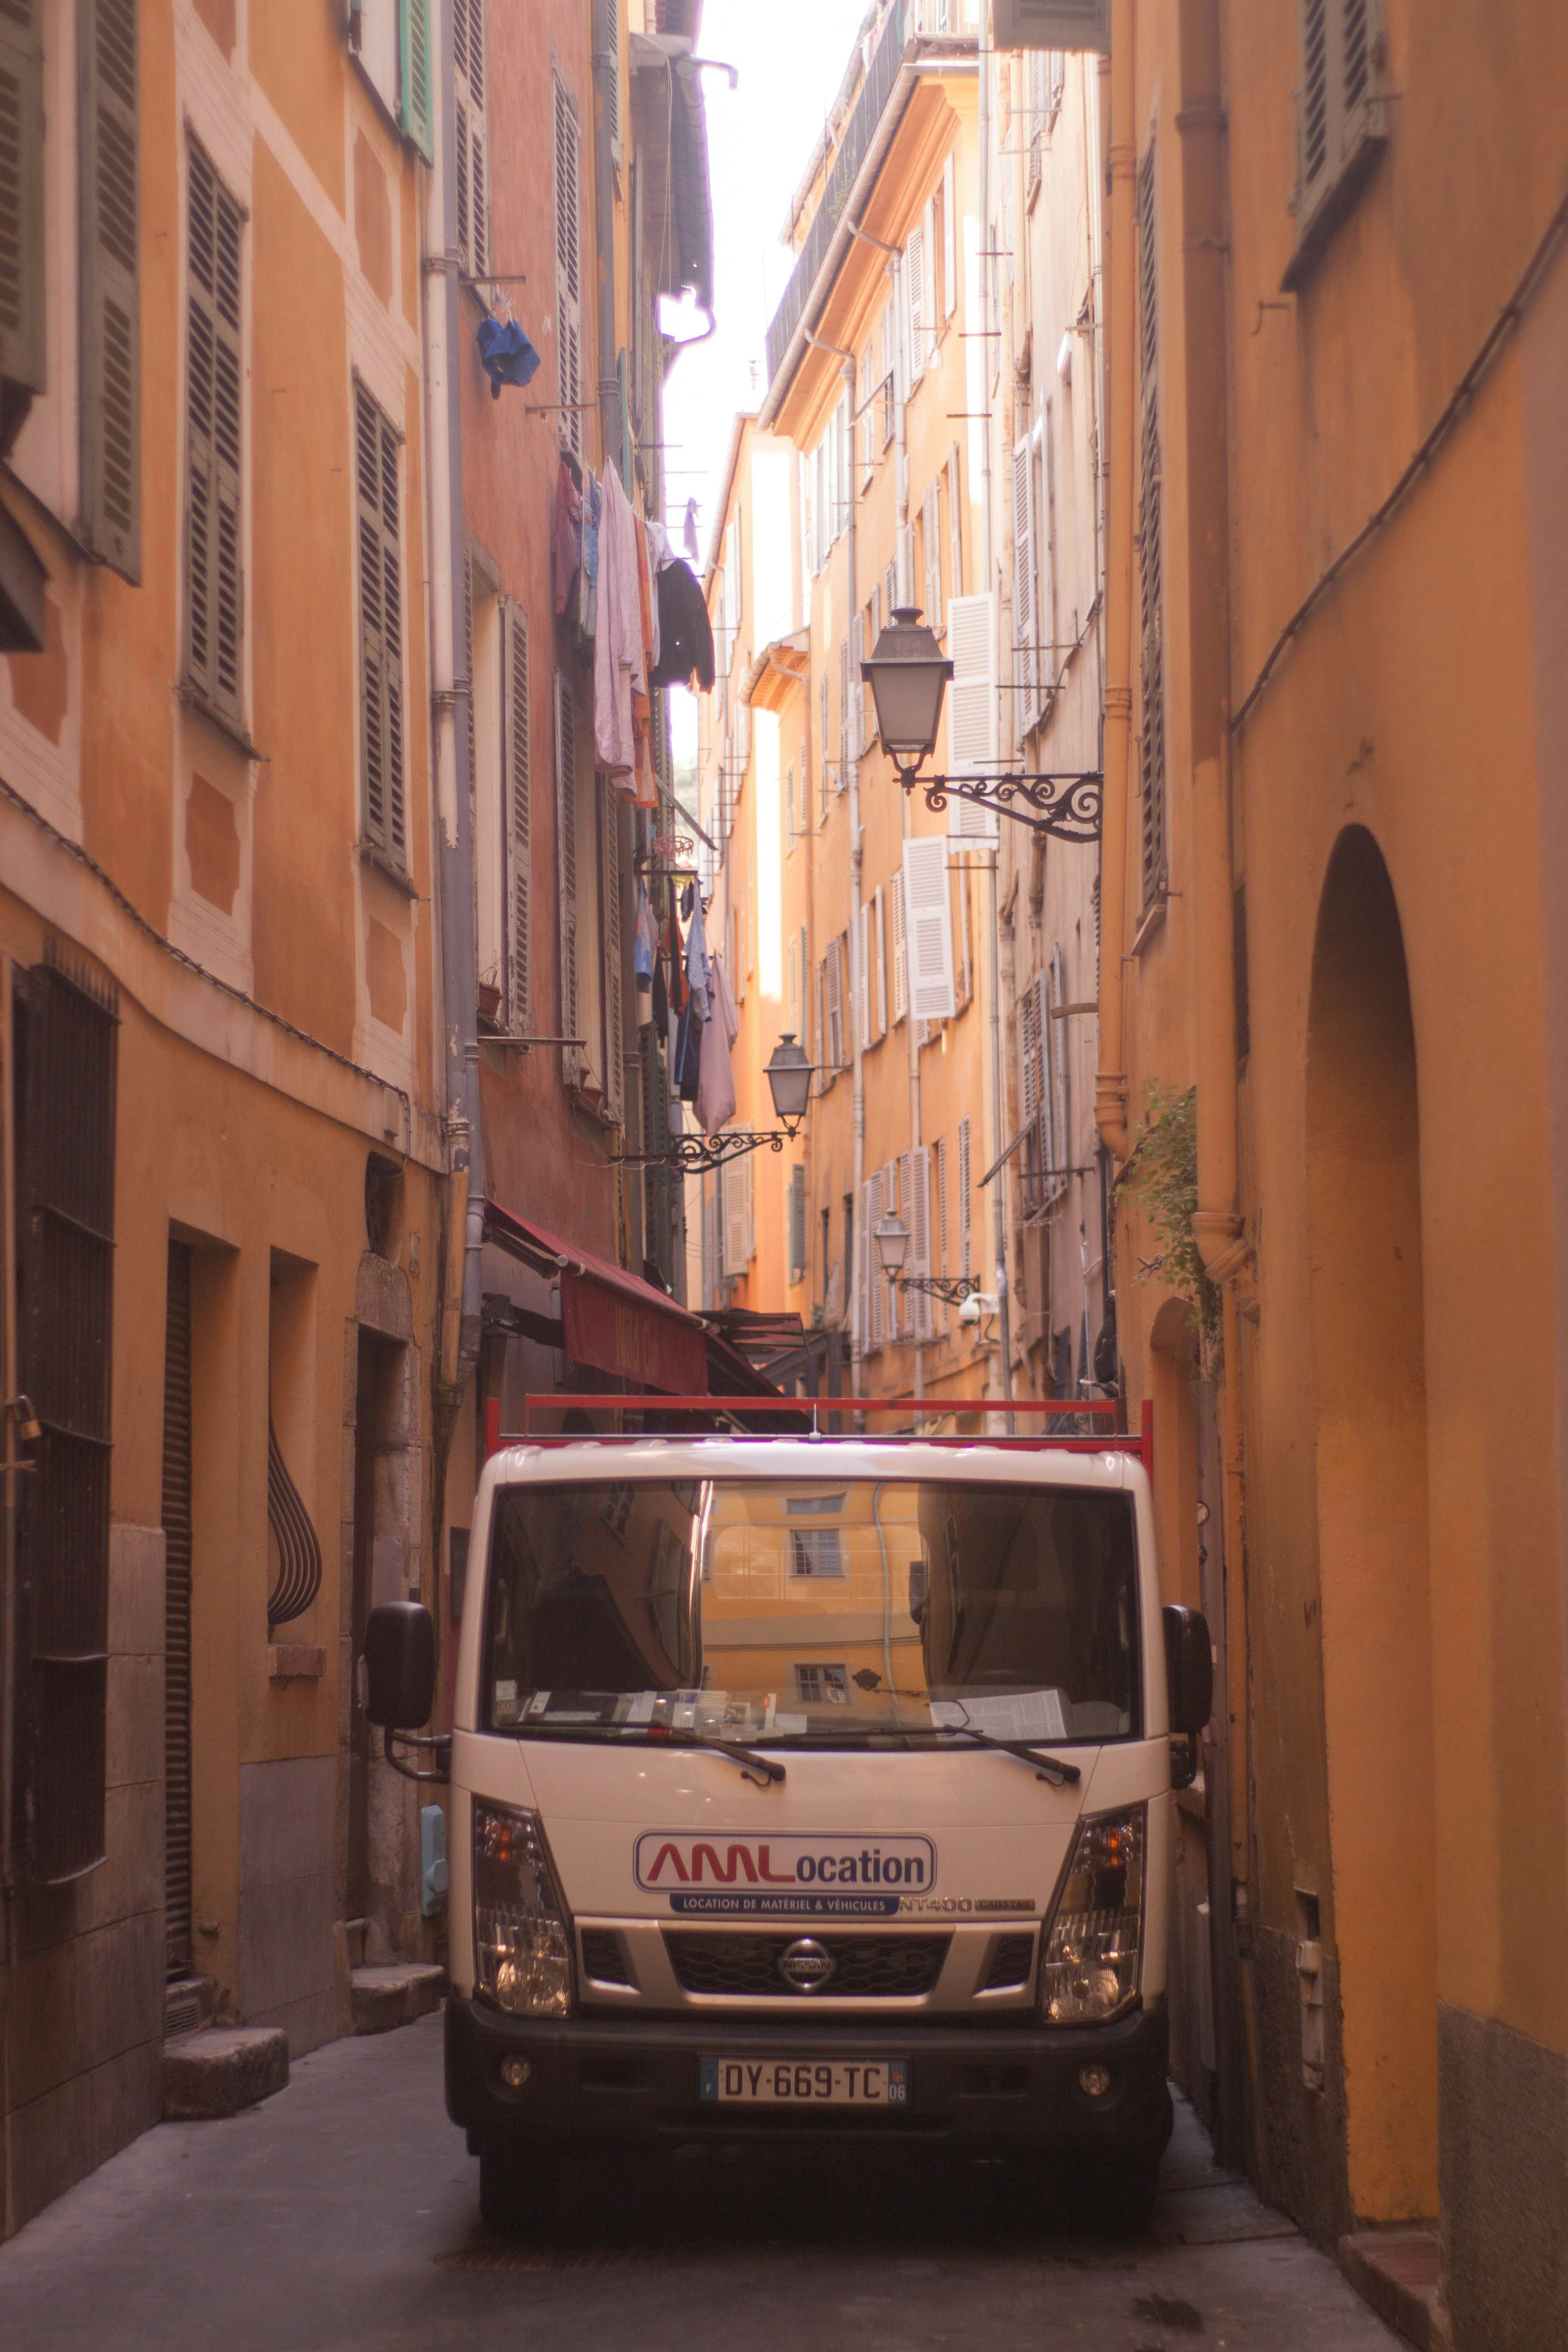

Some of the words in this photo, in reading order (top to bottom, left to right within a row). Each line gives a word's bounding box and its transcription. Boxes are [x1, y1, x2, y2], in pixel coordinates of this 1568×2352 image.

[684, 1898, 739, 1909] LOCATION
[744, 1899, 757, 1909] DE
[761, 1897, 811, 1910] MATÉRIEL
[816, 1900, 823, 1910] &
[828, 1898, 885, 1911] VÉHICULES
[899, 1897, 972, 1911] NT400
[784, 1960, 830, 1969] NISSAN
[725, 2065, 881, 2099] DY-669-TC
[889, 2084, 906, 2100] 06
